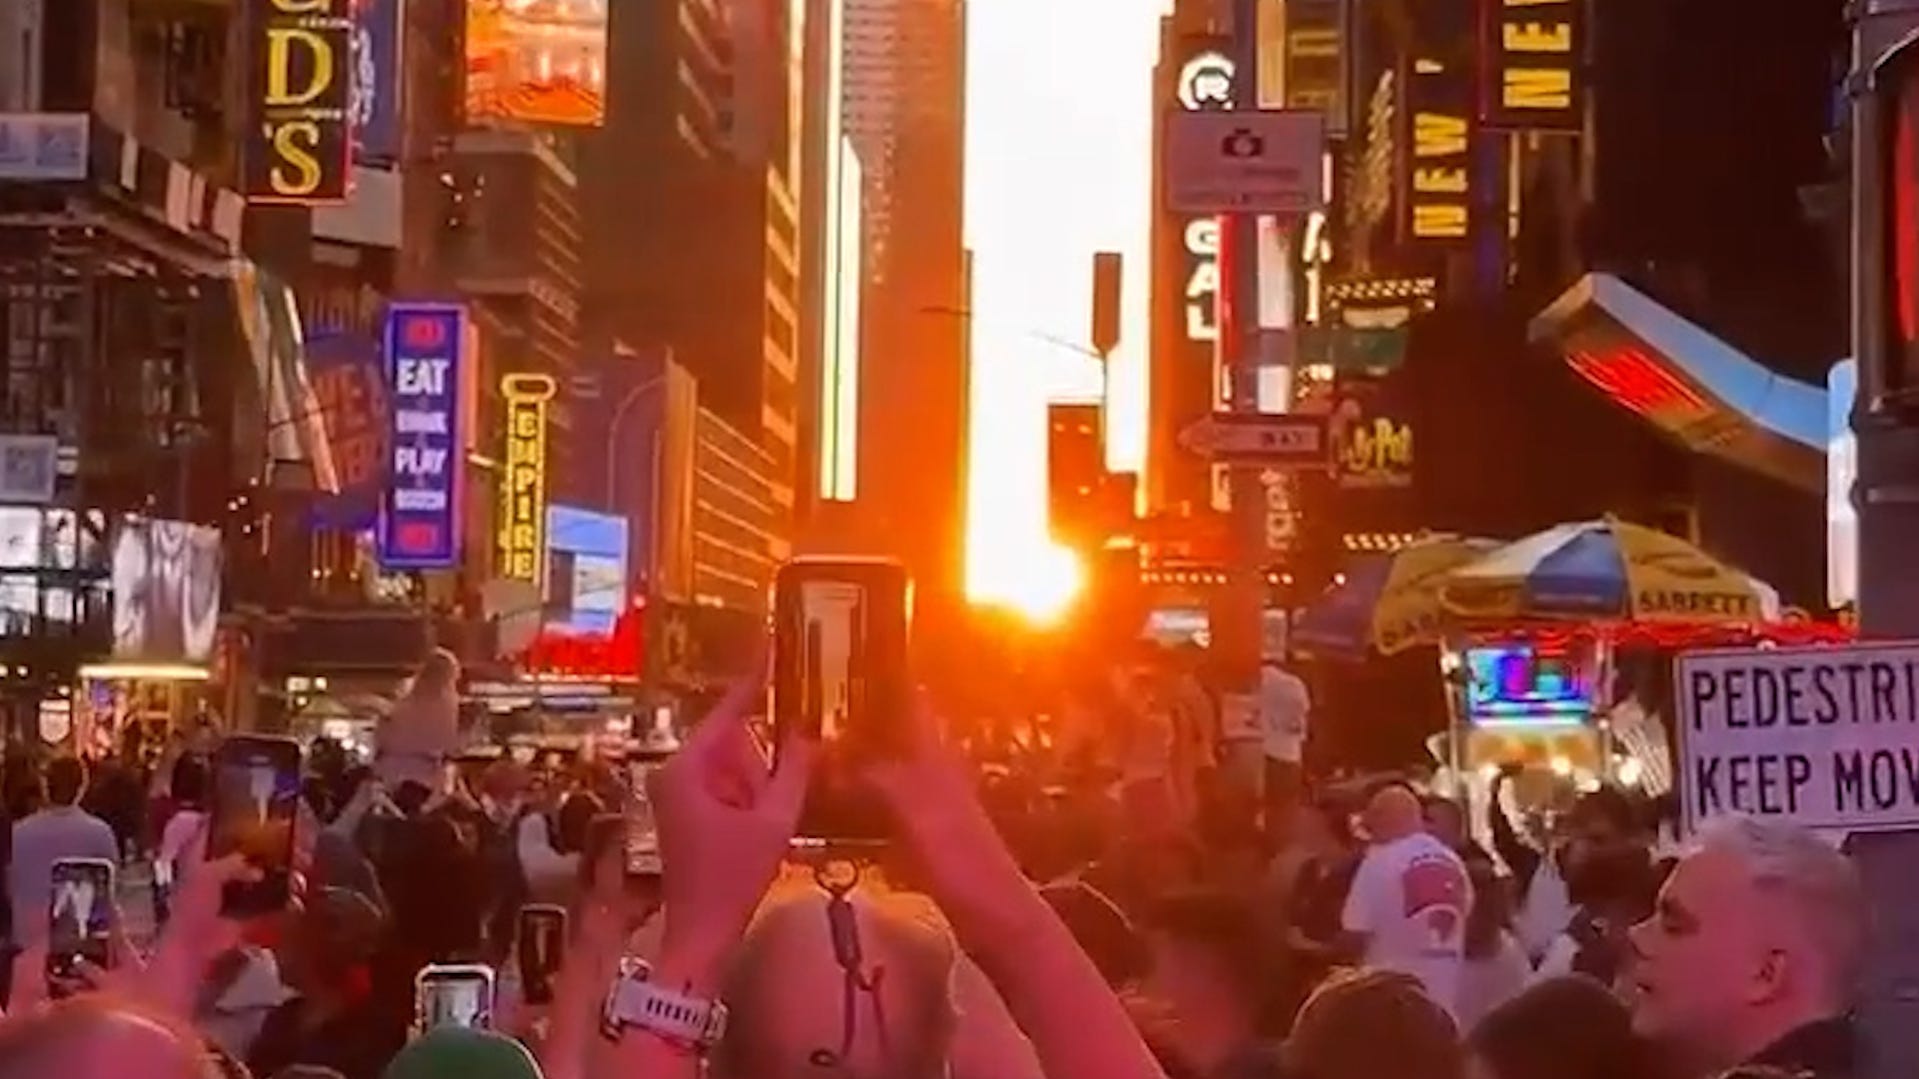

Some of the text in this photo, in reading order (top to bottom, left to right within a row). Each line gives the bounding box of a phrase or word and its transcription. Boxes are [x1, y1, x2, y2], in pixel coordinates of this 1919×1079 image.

[264, 0, 333, 195] D'S
[1503, 0, 1571, 107] NE
[1413, 112, 1468, 237] NEW
[397, 358, 450, 397] EAT
[394, 446, 448, 474] PLAY
[512, 410, 538, 581] EMPIRE
[1691, 661, 1916, 731] PEDESTRI
[1697, 747, 1919, 817] KEEP MOV
